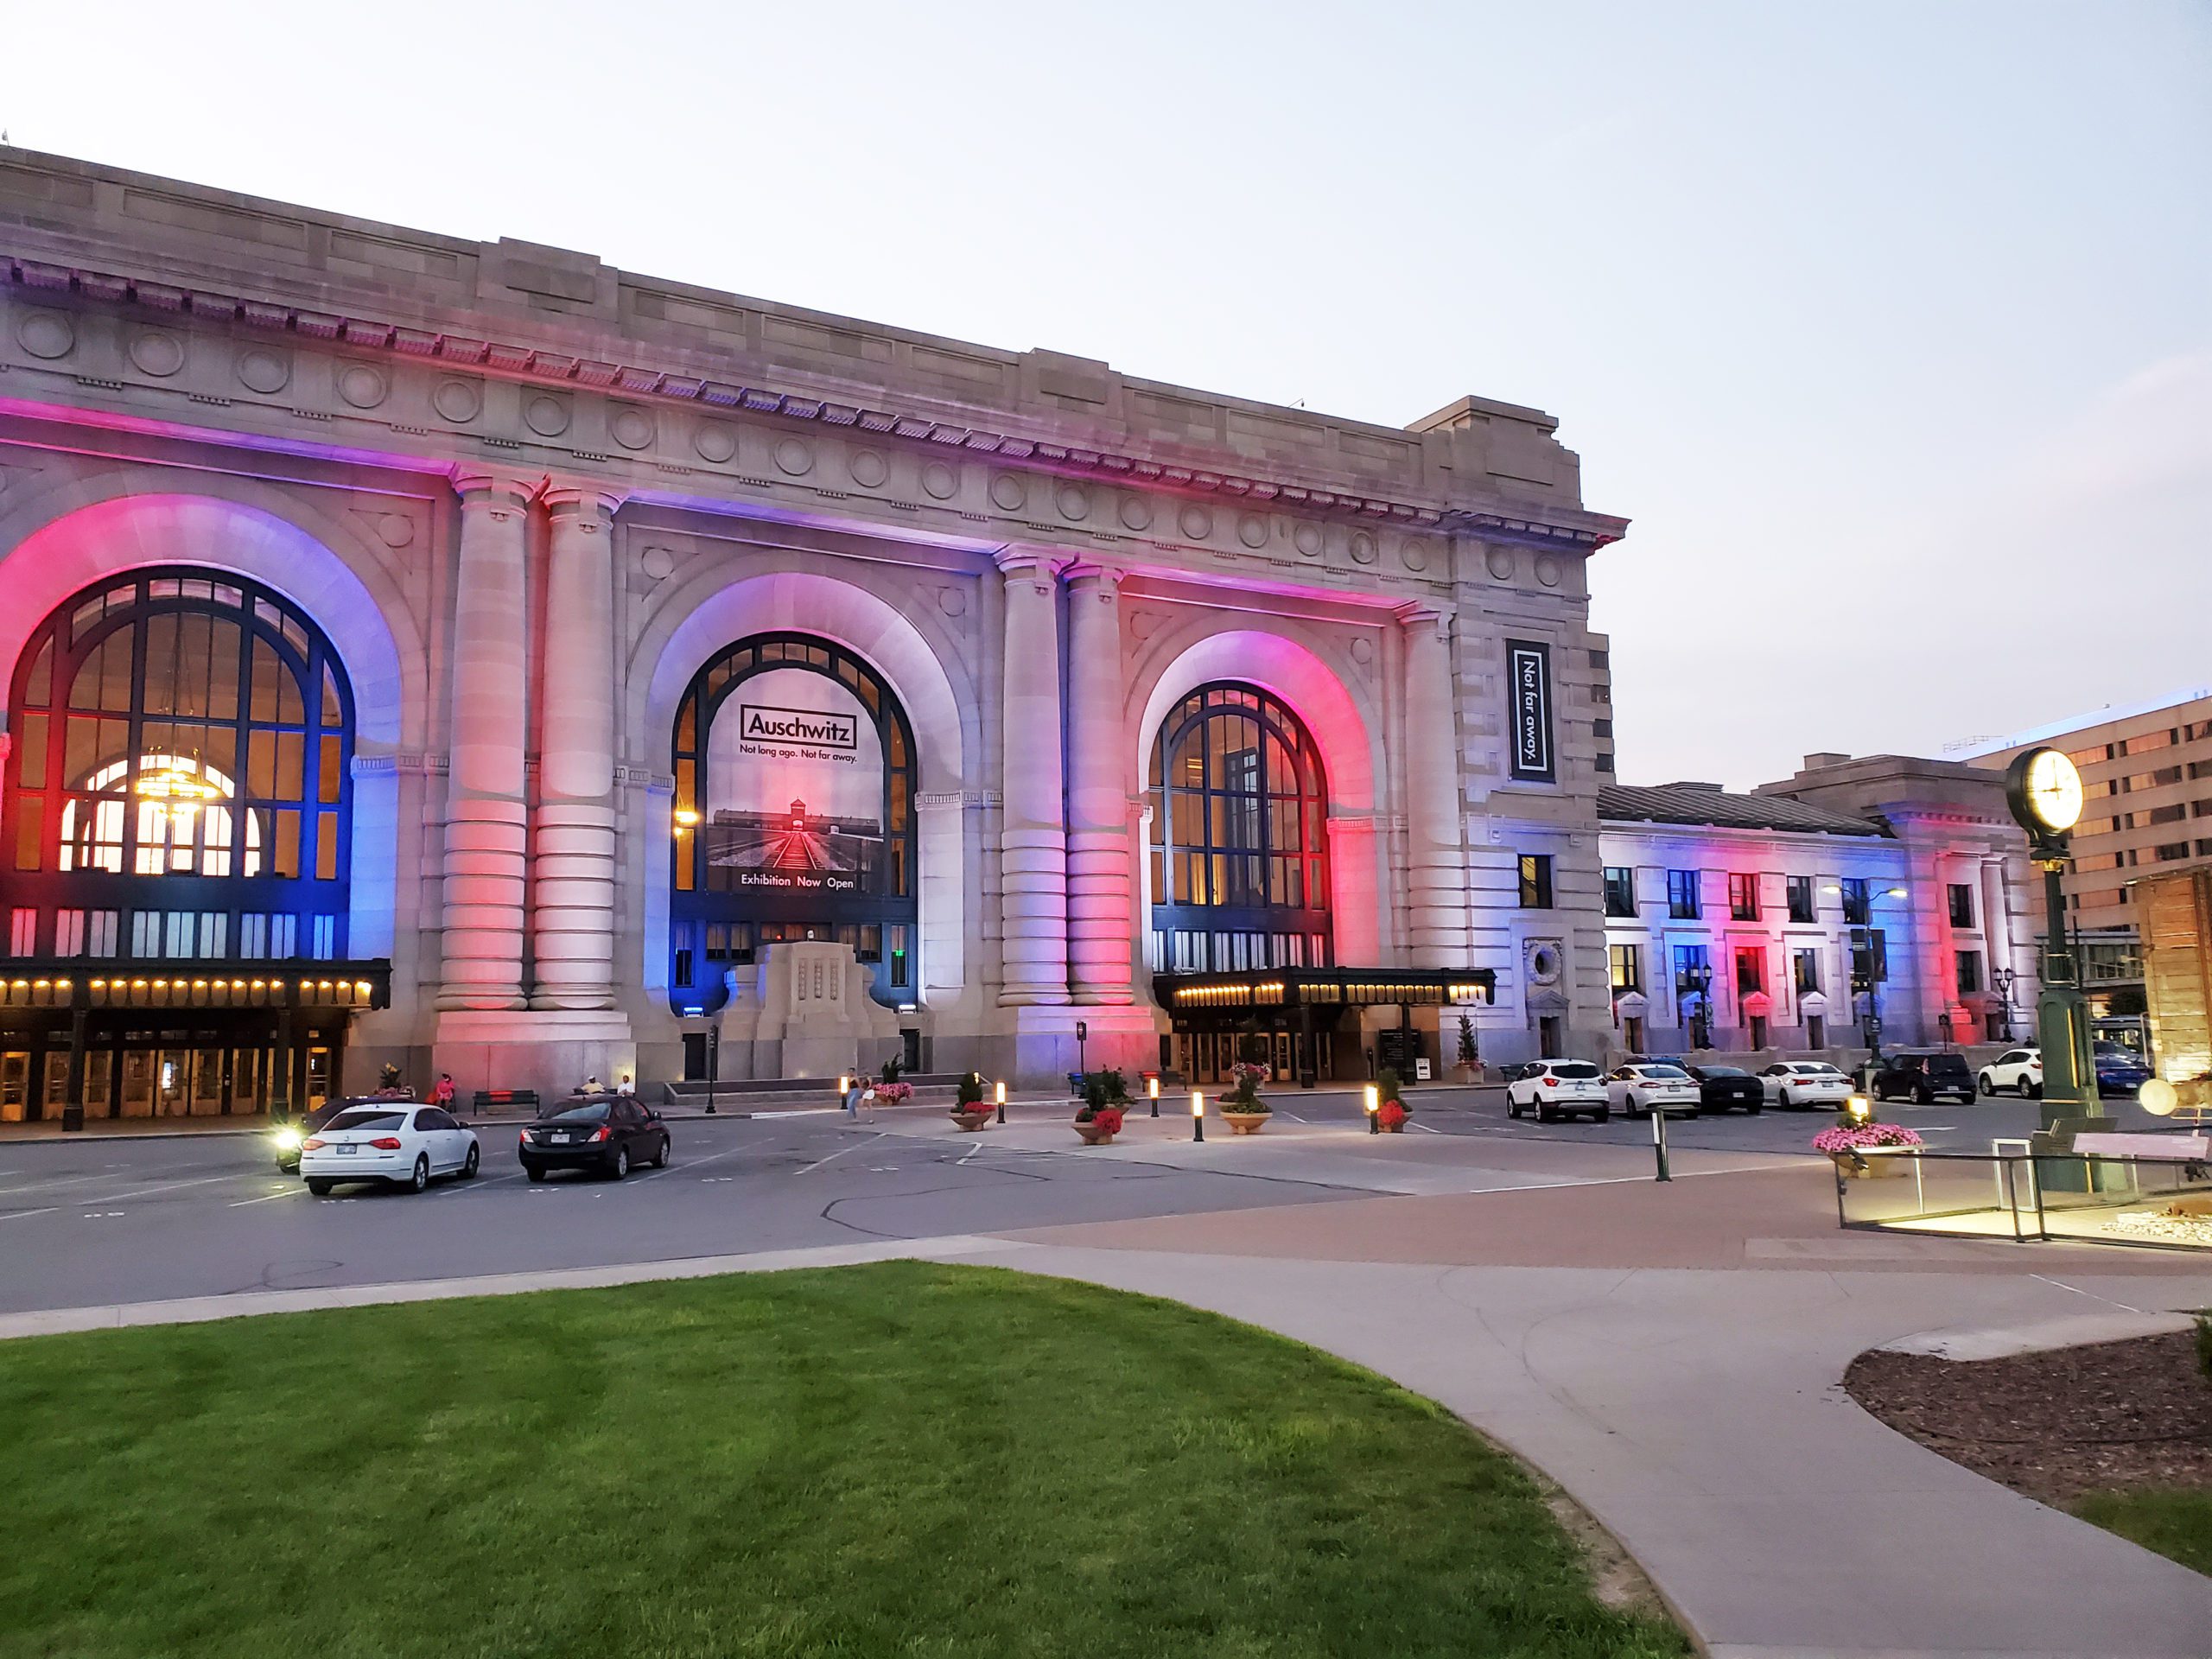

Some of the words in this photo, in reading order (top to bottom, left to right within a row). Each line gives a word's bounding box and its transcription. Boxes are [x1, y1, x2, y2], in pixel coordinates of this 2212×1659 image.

[1523, 661, 1535, 689] Not
[1524, 691, 1538, 714] far
[748, 713, 850, 742] Auschwitz
[1523, 715, 1536, 760] away.
[740, 744, 756, 754] Not
[758, 745, 777, 757] long
[779, 749, 798, 759] ago.
[801, 749, 817, 760] Not
[818, 750, 831, 760] far
[832, 754, 857, 765] away.
[741, 874, 791, 887] Exhibition
[797, 876, 822, 887] Now
[827, 877, 854, 891] Open
